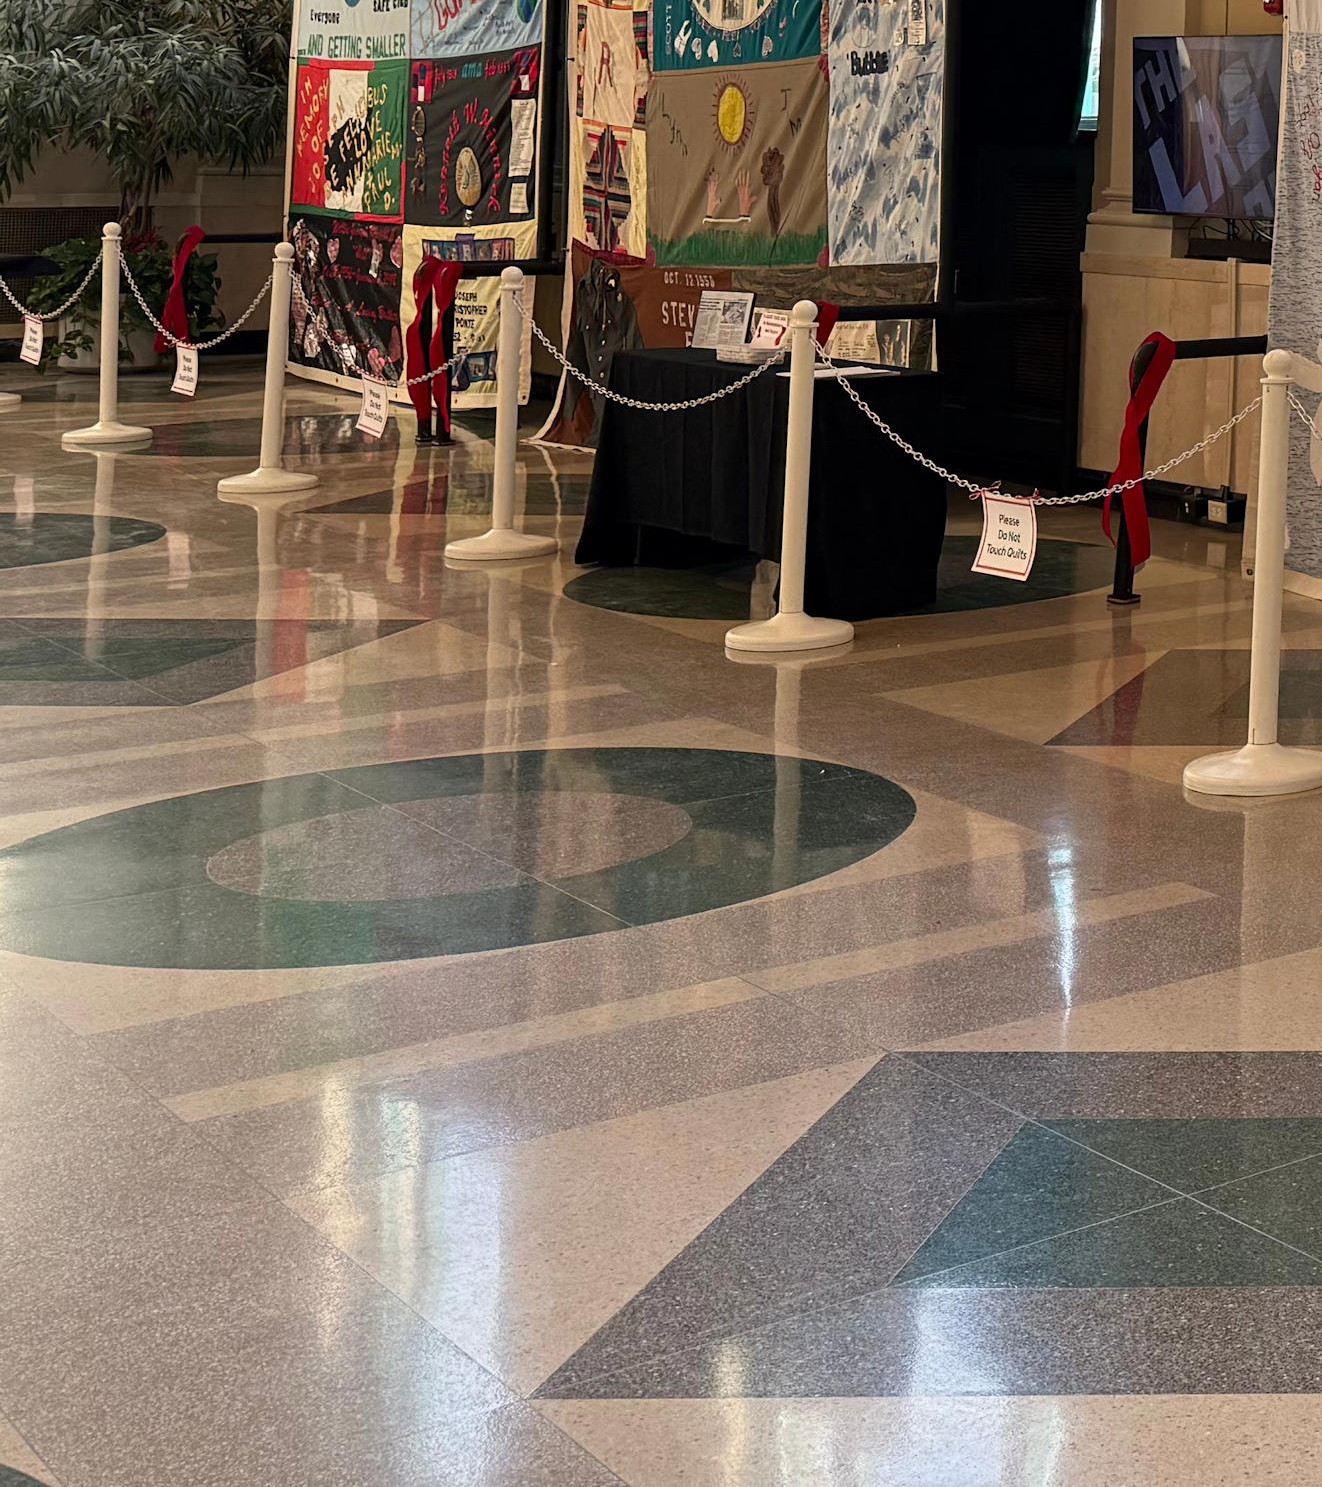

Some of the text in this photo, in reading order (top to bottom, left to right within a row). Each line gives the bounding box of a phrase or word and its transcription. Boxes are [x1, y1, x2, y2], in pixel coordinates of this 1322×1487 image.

[328, 33, 406, 59] GETTING SMALLER
[998, 514, 1020, 527] Please
[998, 529, 1021, 543] Do Not
[986, 543, 1027, 560] Touch Quilts
